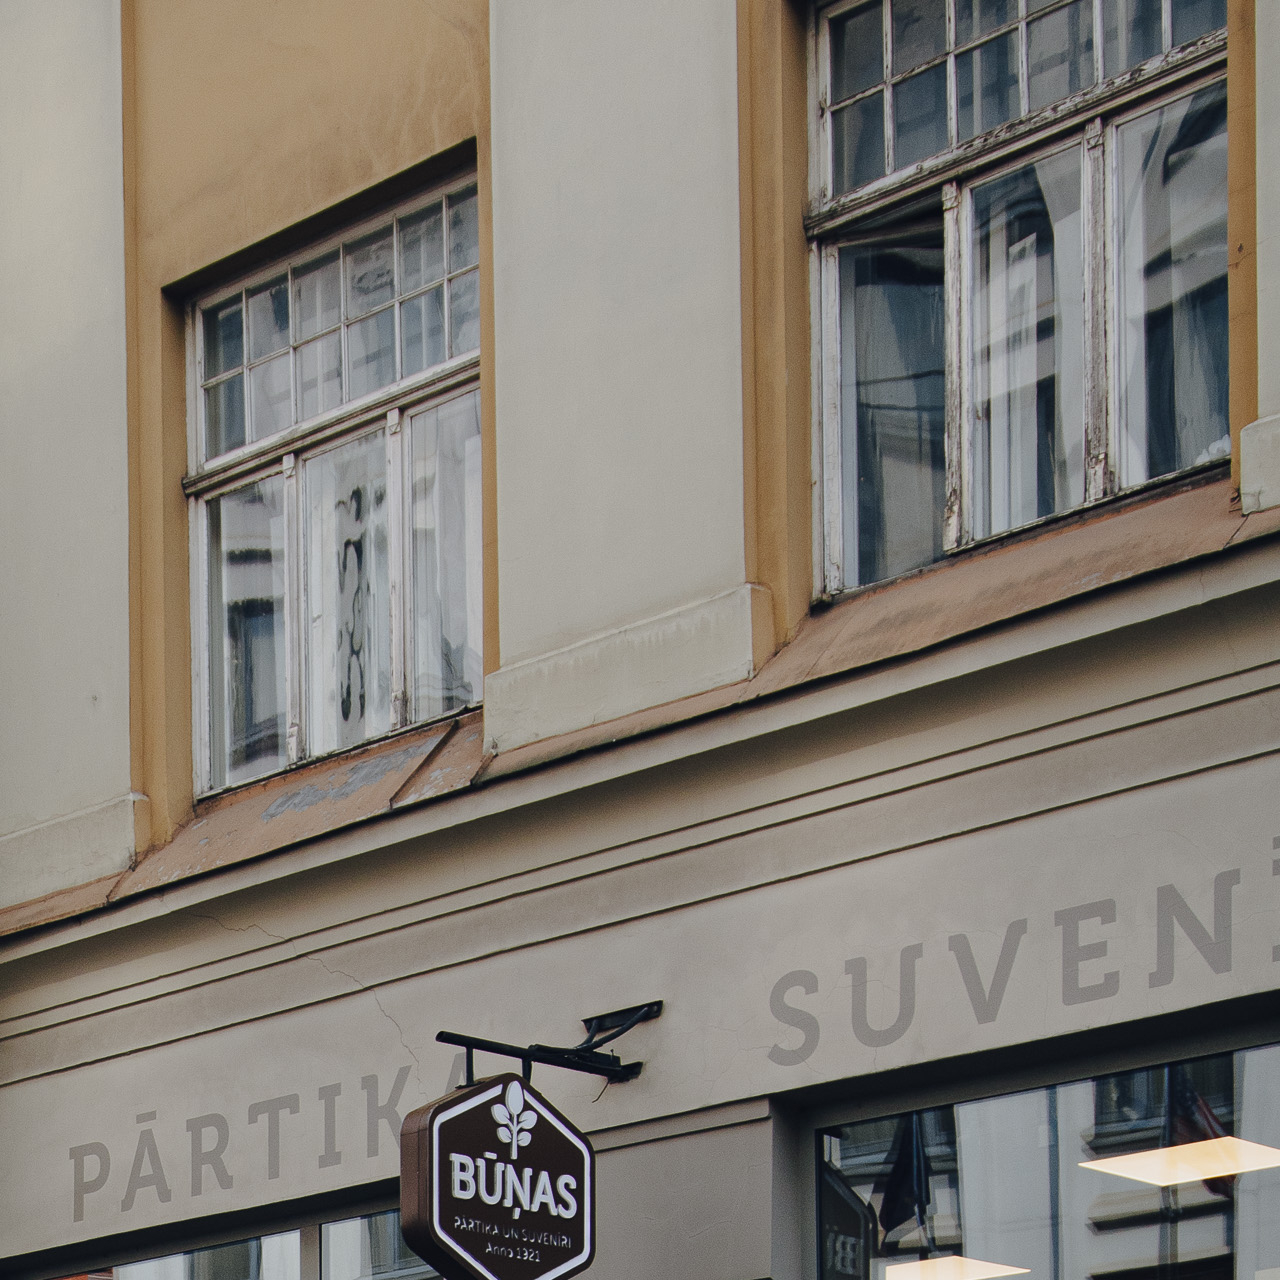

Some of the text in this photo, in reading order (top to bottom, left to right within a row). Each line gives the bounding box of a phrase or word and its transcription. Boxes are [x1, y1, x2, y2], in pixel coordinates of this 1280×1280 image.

[767, 834, 1280, 1067] SUVEN
[450, 1152, 577, 1220] BŪŅAS
[454, 1215, 500, 1236] PĀRTIKA
[503, 1227, 519, 1240] UN
[486, 1242, 514, 1258] Anno
